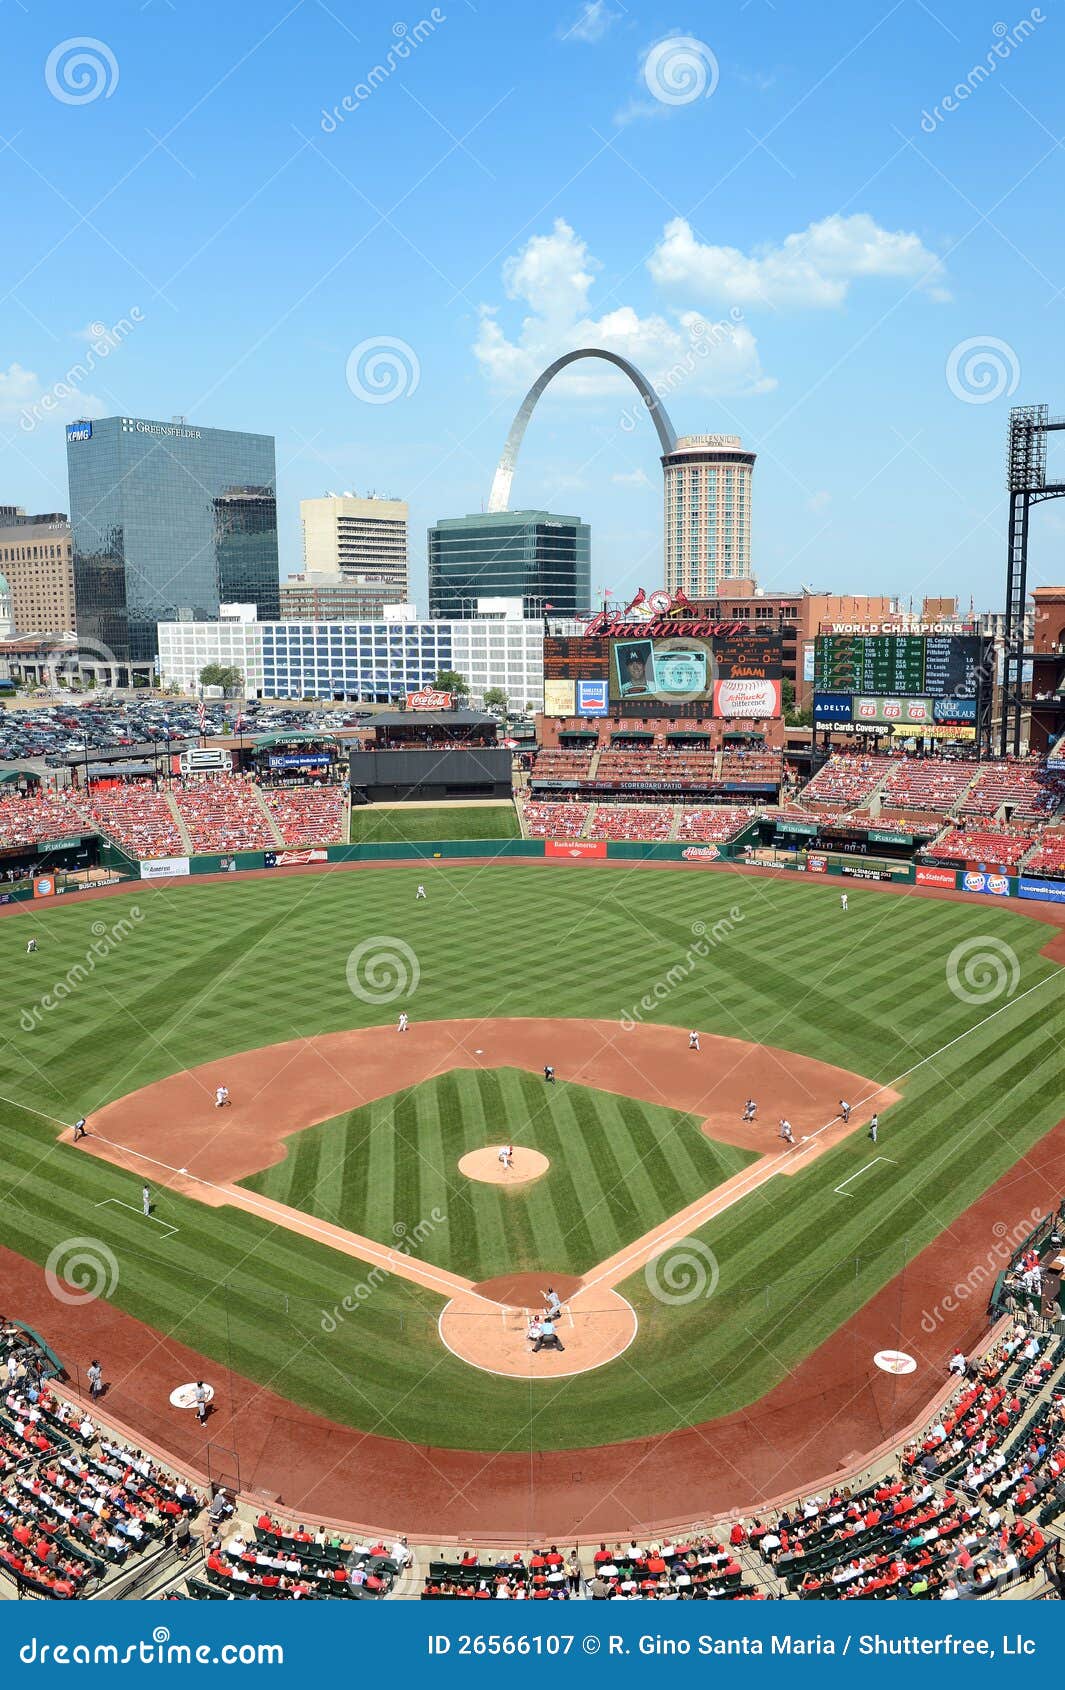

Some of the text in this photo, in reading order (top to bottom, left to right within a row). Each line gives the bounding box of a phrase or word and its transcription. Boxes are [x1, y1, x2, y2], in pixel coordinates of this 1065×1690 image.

[67, 429, 89, 442] KPMG
[136, 422, 201, 439] GREENSFELDER
[691, 435, 737, 443] MILLENNIU
[576, 610, 745, 637] Budweiser
[832, 622, 962, 633] WORLD CHAMPIONS
[834, 722, 854, 732] Cards
[856, 725, 888, 734] Coverage
[98, 878, 119, 886] STADIUM
